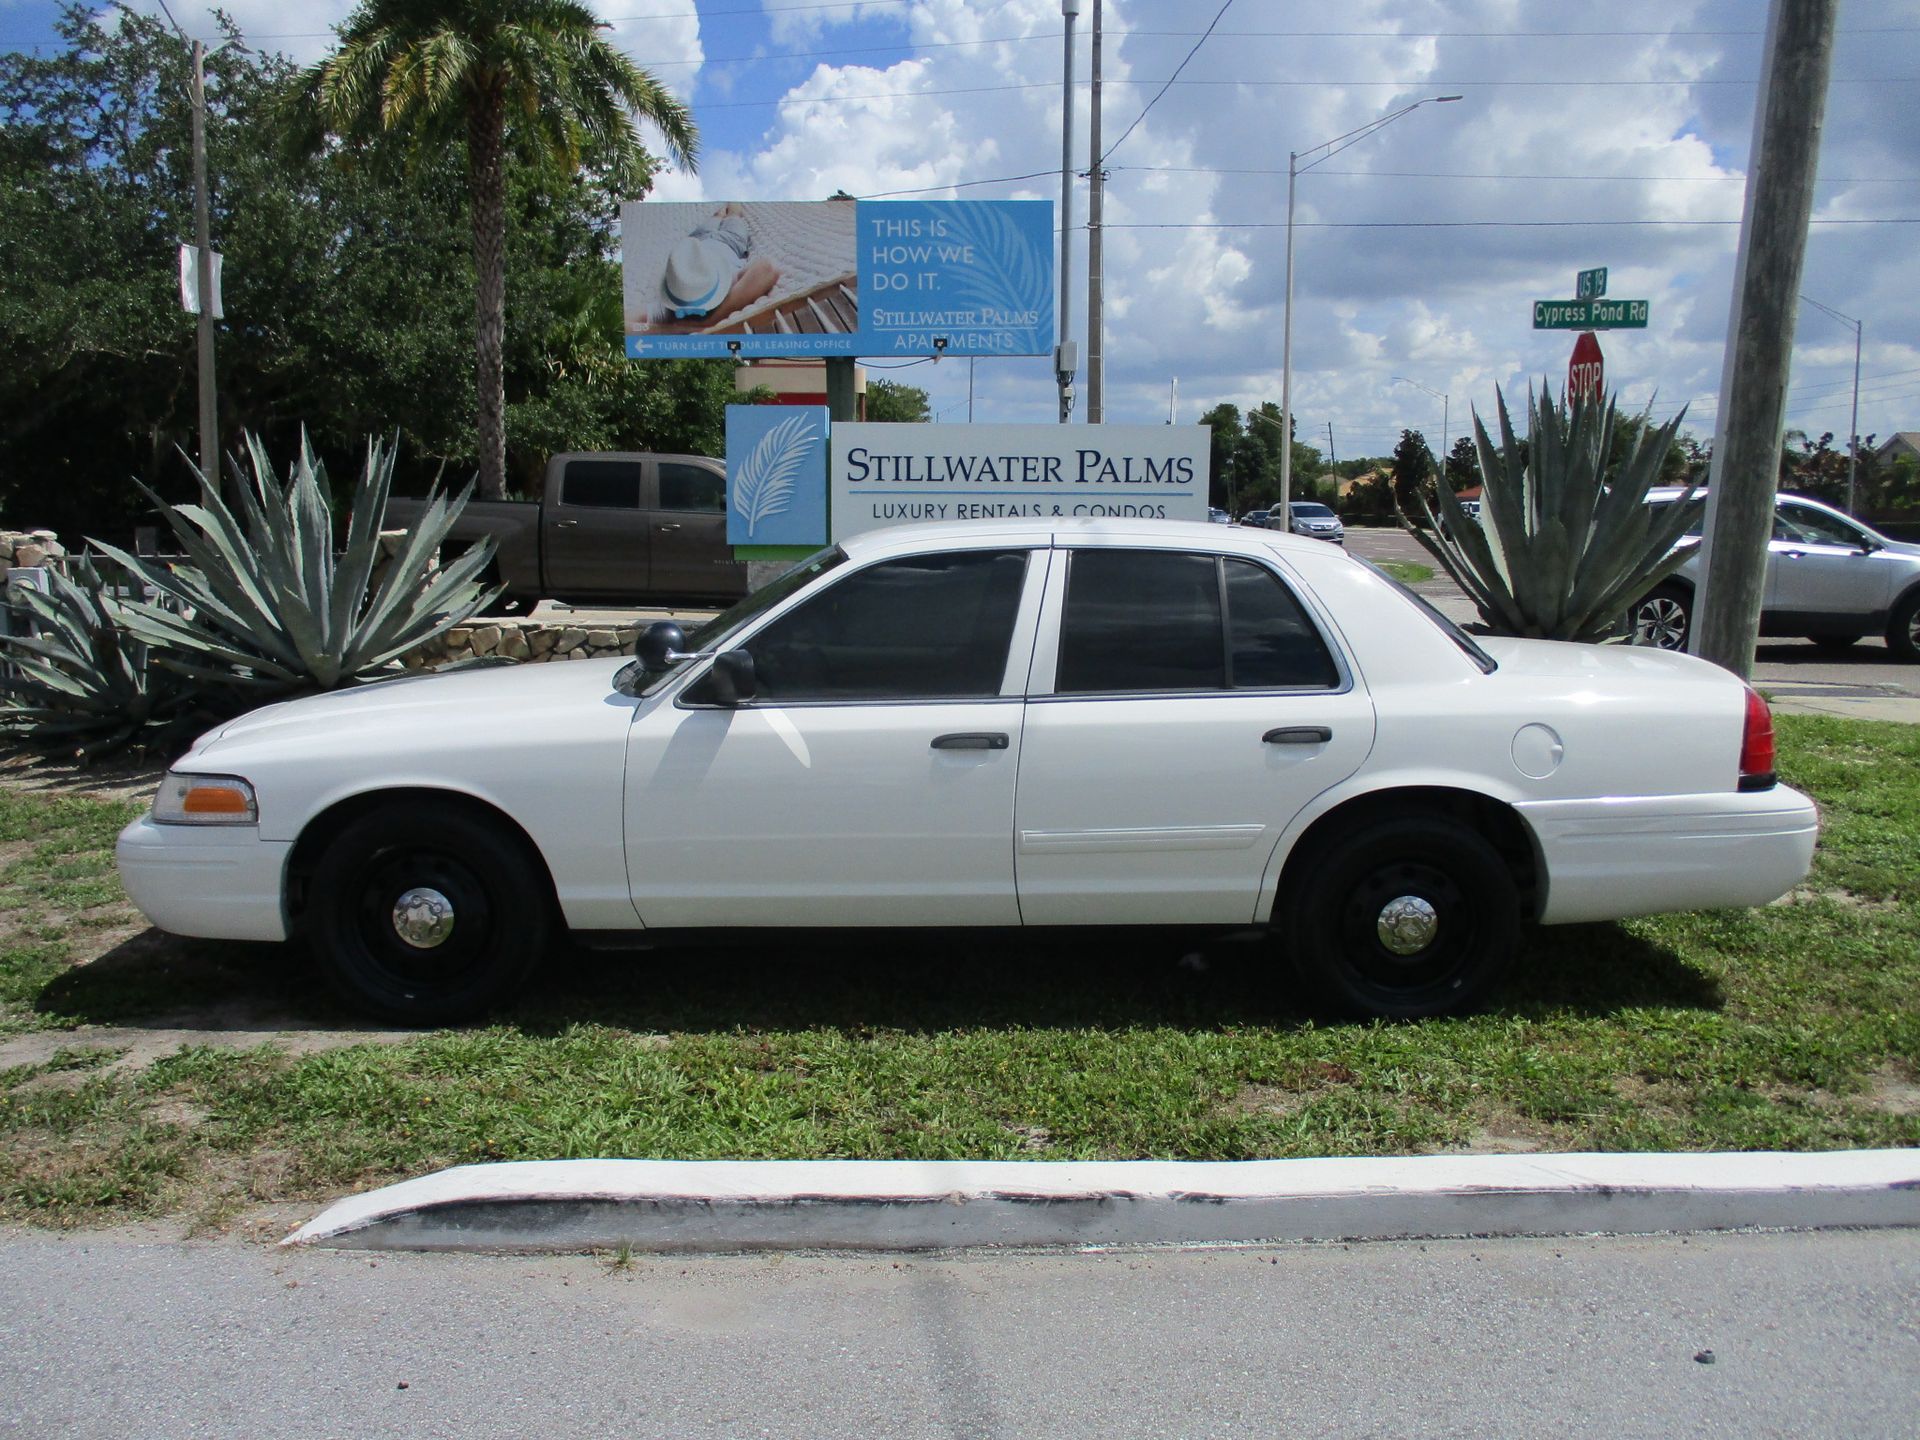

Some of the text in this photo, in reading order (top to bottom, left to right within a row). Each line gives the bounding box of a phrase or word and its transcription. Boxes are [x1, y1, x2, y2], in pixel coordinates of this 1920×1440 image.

[872, 219, 947, 238] THIS IS
[873, 245, 974, 265] HOW WE
[873, 272, 941, 291] DO IT.
[1579, 270, 1604, 297] US 19
[872, 307, 1039, 326] STILLWATER PALMS
[1535, 302, 1647, 327] Cypress Pond Rd
[657, 340, 688, 350] TURN
[691, 340, 716, 350] LEFT
[765, 339, 810, 350] LEASING
[814, 339, 851, 349] OFFICE
[1570, 361, 1601, 399] STOP
[847, 447, 1194, 484] STILLWATER PALMS
[872, 503, 948, 519] LUXURY
[1051, 504, 1064, 517] &
